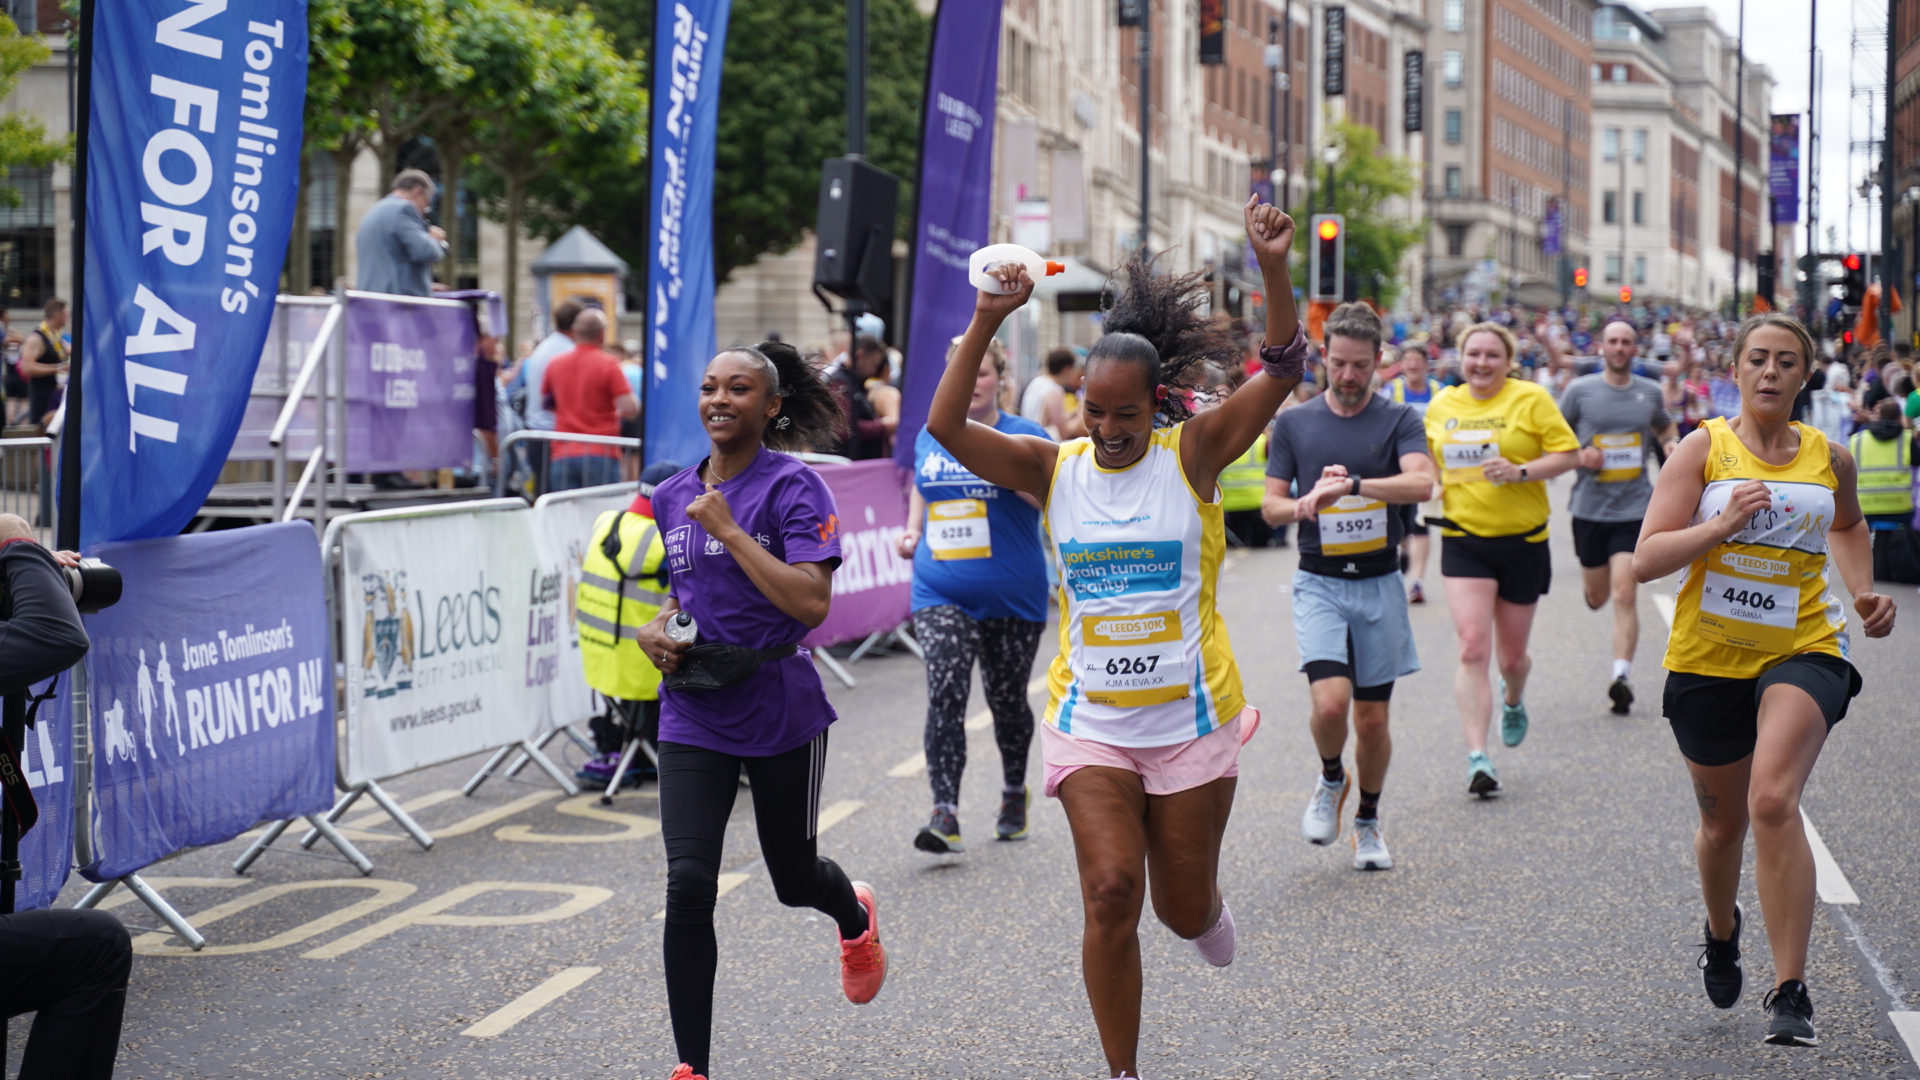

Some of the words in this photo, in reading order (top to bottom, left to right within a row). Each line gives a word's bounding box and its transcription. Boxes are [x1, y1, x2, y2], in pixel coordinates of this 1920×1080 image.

[665, 2, 694, 140] RUN
[685, 21, 709, 103] Jane
[140, 73, 219, 266] FOR
[221, 19, 284, 315] Tomlinson's
[658, 146, 680, 269] FOR
[653, 280, 669, 390] ALL
[124, 283, 197, 454] ALL
[962, 486, 999, 499] Leeds
[1336, 518, 1373, 533] 5592
[667, 530, 685, 545] THIS
[1766, 536, 1792, 545] ANCER
[667, 544, 684, 556] GIRL
[1062, 546, 1155, 566] yorkshire's
[670, 556, 685, 568] CAN
[1066, 563, 1107, 580] brain
[1109, 561, 1177, 575] tumour
[1737, 557, 1768, 570] LEEDS
[1769, 562, 1788, 574] 10K
[1704, 586, 1712, 594] M
[1722, 587, 1776, 610] 4406
[415, 570, 501, 659] Leeds
[1730, 608, 1763, 621] GEMMA
[1110, 621, 1141, 633] LEEDS
[1142, 619, 1163, 631] 10K
[182, 637, 219, 672] Jane
[217, 617, 294, 663] Tomlinson's
[1105, 654, 1160, 676] 6267
[416, 665, 445, 689] CITY
[1105, 679, 1123, 688] KJM
[1124, 679, 1130, 687] 4
[1132, 678, 1150, 687] EVA
[1151, 676, 1165, 685] XX
[185, 678, 248, 750] RUN
[247, 667, 296, 732] FOR
